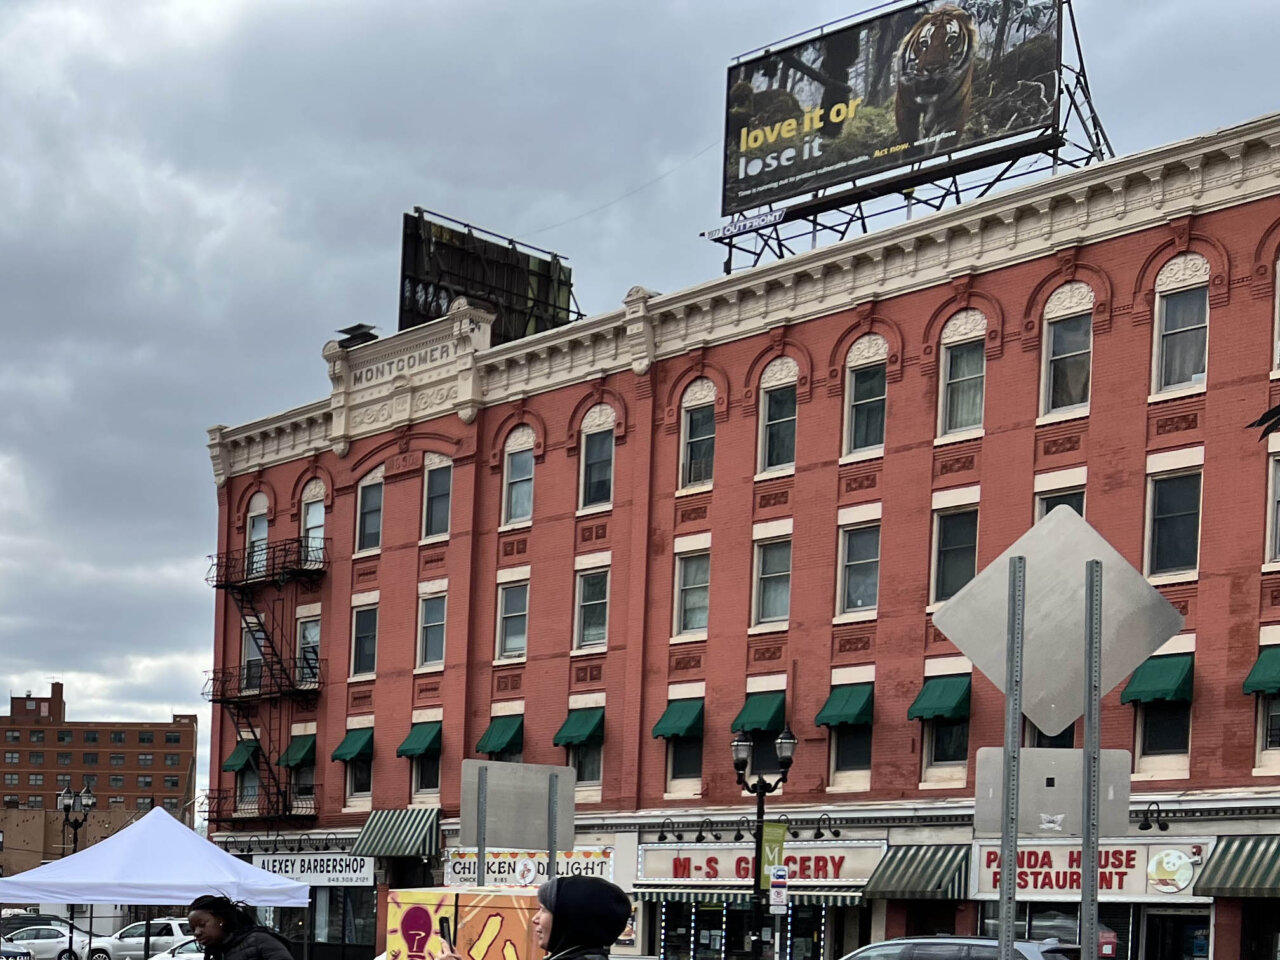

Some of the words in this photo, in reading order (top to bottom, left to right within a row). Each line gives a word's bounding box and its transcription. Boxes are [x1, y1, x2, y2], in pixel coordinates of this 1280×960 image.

[740, 118, 797, 152] love
[803, 106, 824, 132] it
[829, 97, 864, 123] or
[738, 147, 796, 179] lose
[803, 135, 823, 160] it
[873, 149, 889, 158] Act
[890, 142, 910, 153] now.
[724, 211, 782, 235] OUTFRONT
[353, 342, 459, 386] MONTGOMERY
[261, 859, 296, 874] ALEXEY
[300, 857, 365, 873] BARBERSHOP
[452, 860, 516, 876] CHIKEN
[673, 856, 719, 879] M-S
[735, 855, 845, 879] GCERY
[1068, 850, 1137, 869] HUSE
[992, 871, 1128, 889] RSTAURNT
